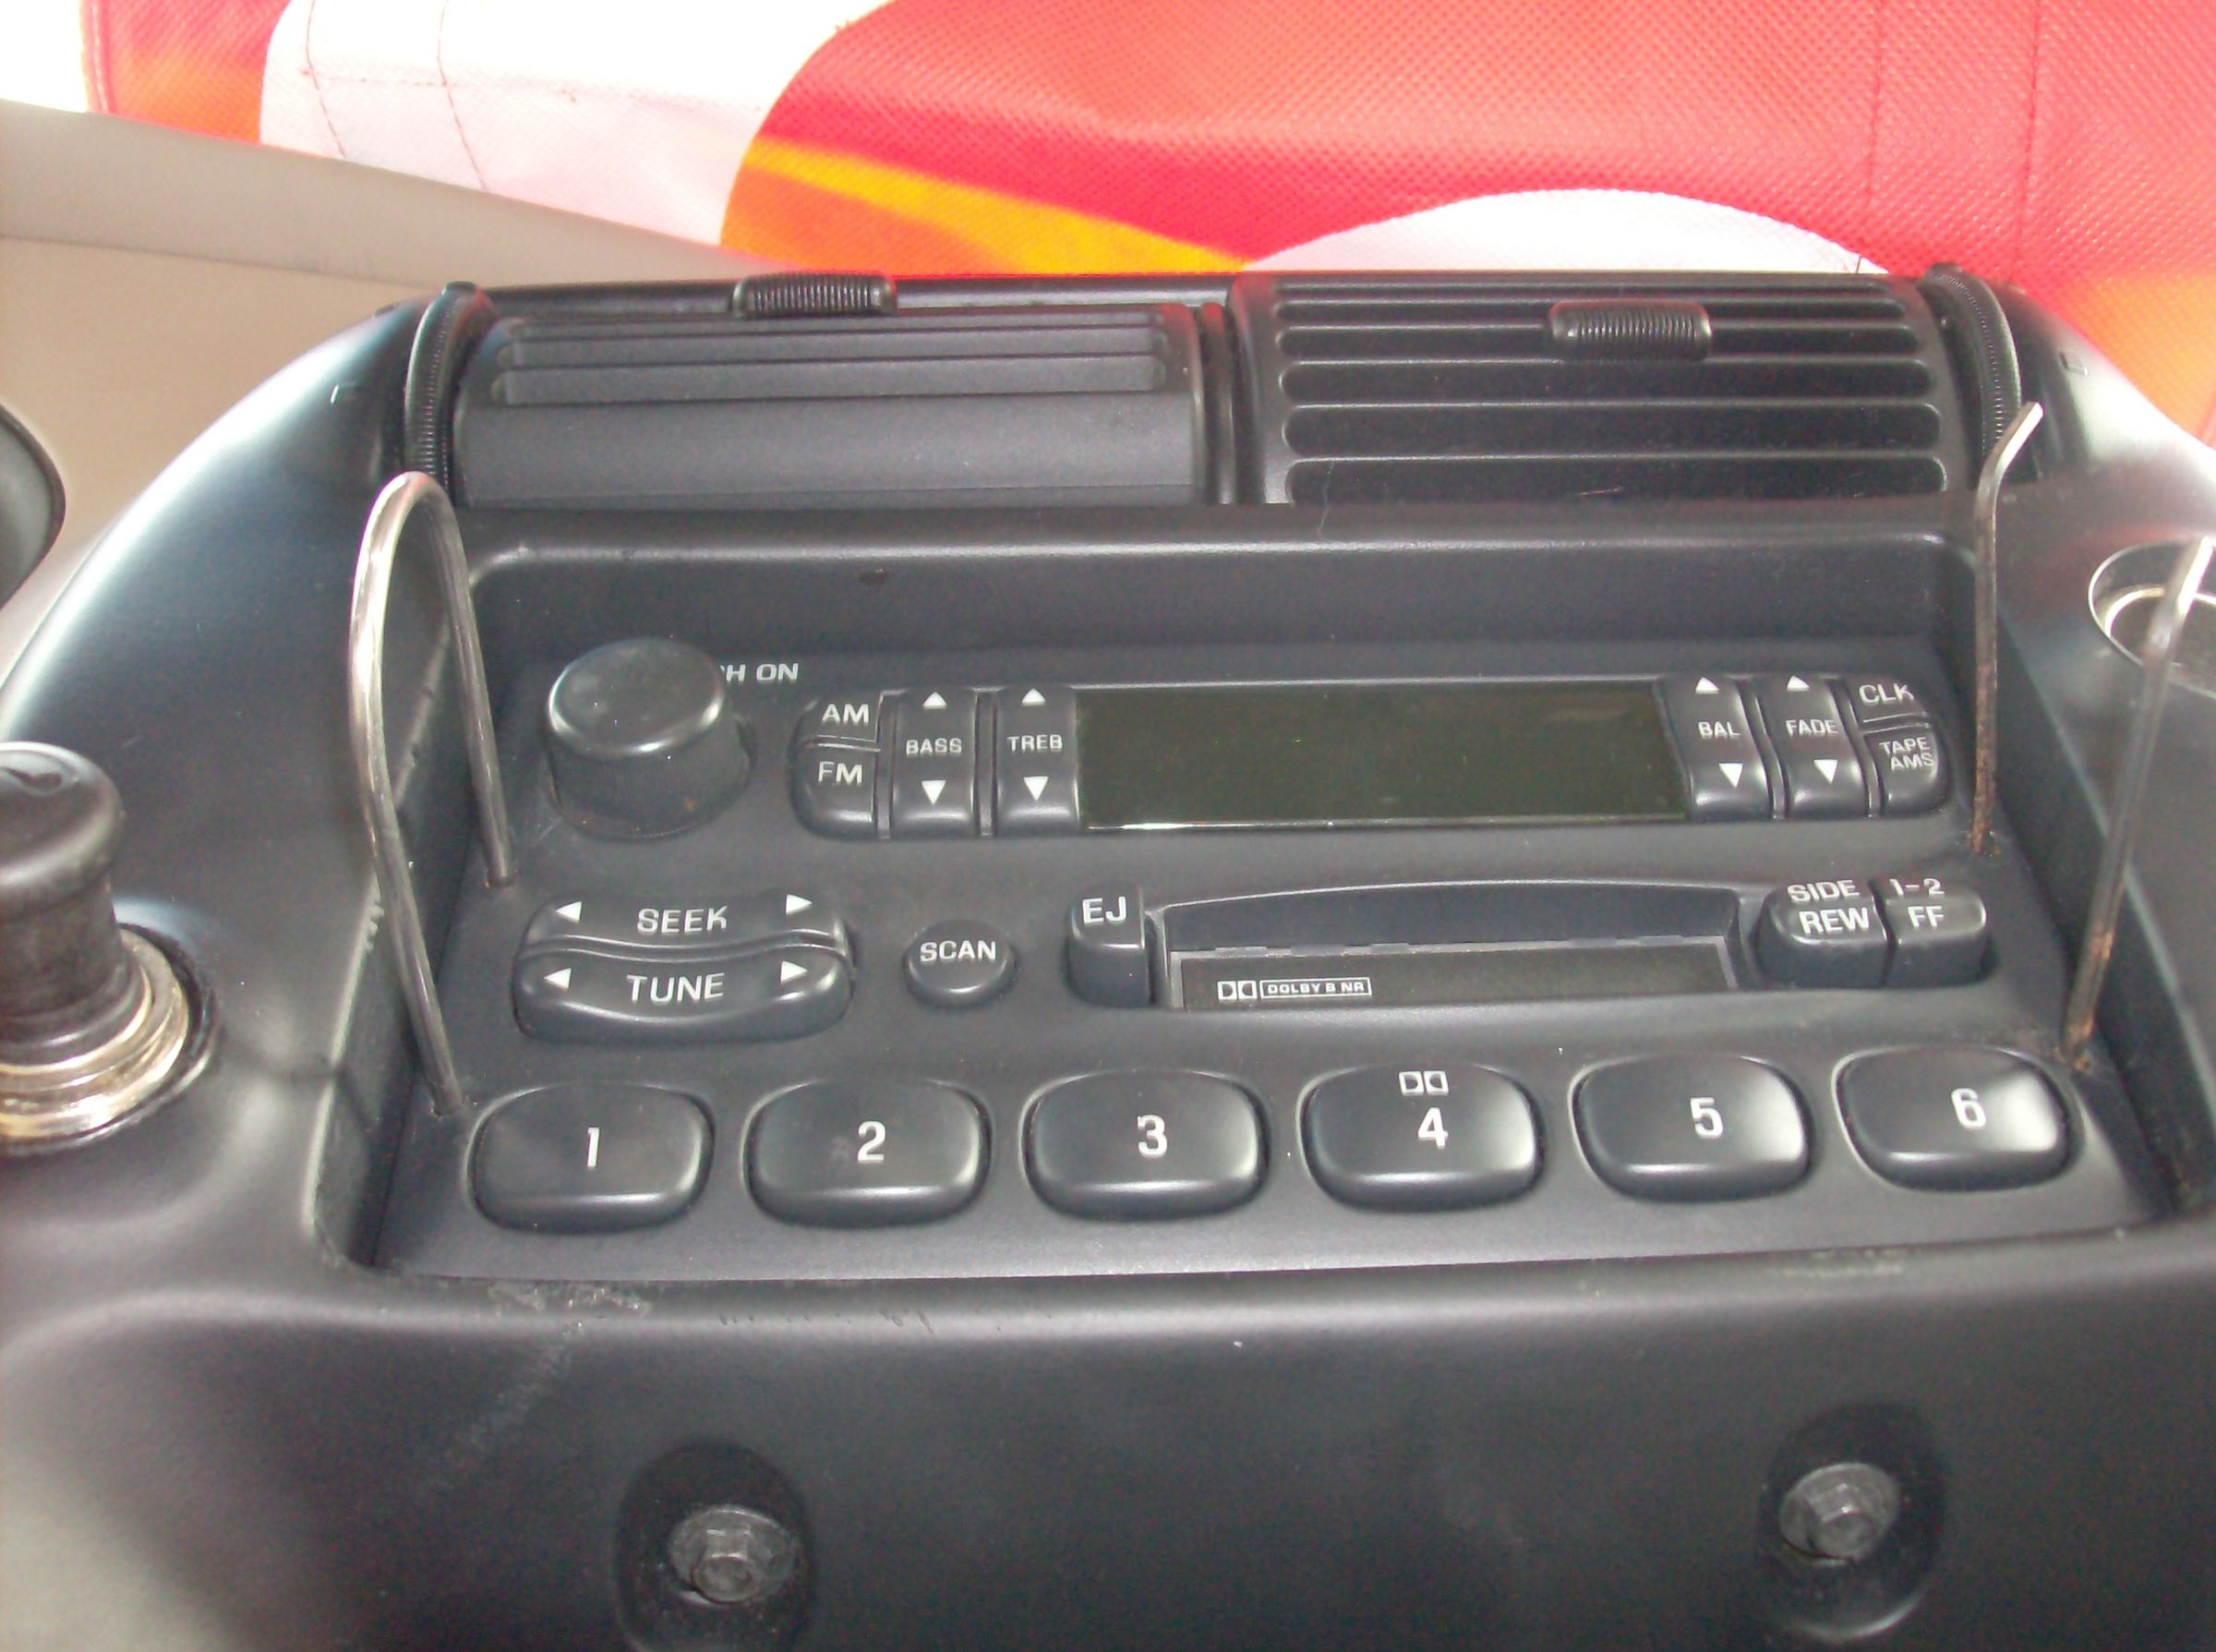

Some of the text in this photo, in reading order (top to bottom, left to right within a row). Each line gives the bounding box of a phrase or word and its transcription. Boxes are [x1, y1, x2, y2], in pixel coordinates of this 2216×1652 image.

[756, 663, 799, 681] ON
[1859, 683, 1915, 705] CLK
[822, 704, 870, 725] AM
[1697, 720, 1740, 738] BAL
[1786, 718, 1838, 736] FADE
[905, 739, 962, 755] BASS
[1008, 735, 1062, 752] TREB
[1879, 737, 1931, 754] TAPE
[817, 761, 863, 785] FM
[1890, 753, 1935, 771] AMS
[1787, 877, 1945, 903] SIDE 1-2
[636, 906, 728, 934] SEEK
[1081, 896, 1128, 924] EJ
[1798, 907, 1871, 935] REW
[1908, 905, 1945, 928] FF
[919, 940, 998, 962] SCAN
[626, 972, 725, 1004] TUNE
[1267, 982, 1365, 995] DOLBY B NR
[1690, 1097, 1724, 1139] 5
[1950, 1088, 1986, 1129] 6
[1137, 1115, 1168, 1159] 3
[1417, 1107, 1449, 1149] 4
[584, 1127, 601, 1168] 1
[856, 1121, 885, 1165] 2
